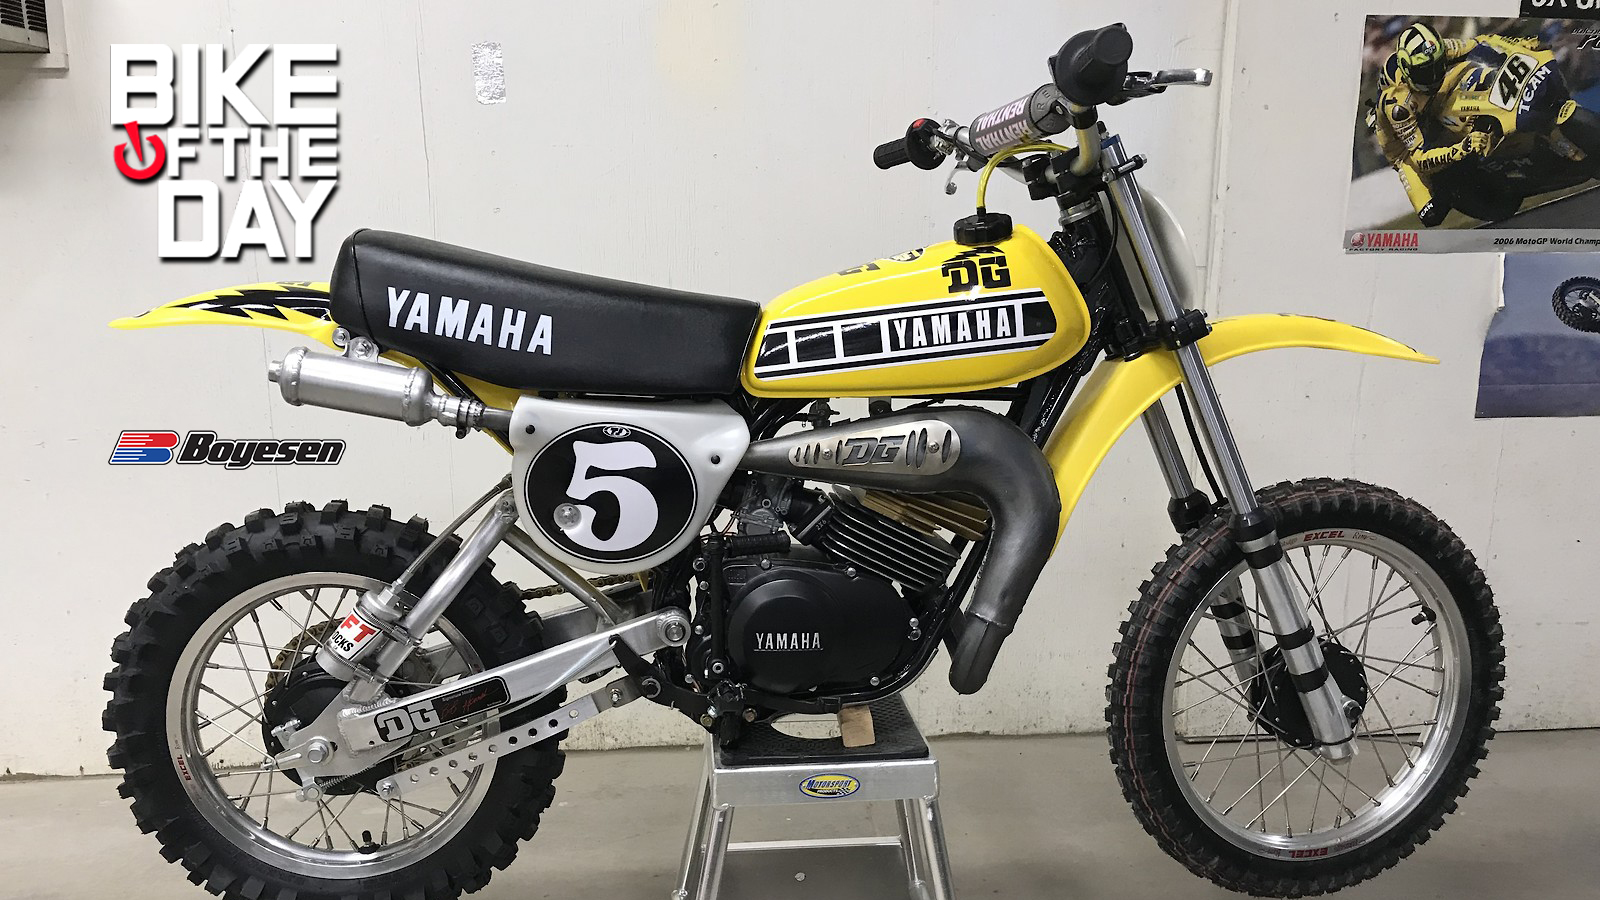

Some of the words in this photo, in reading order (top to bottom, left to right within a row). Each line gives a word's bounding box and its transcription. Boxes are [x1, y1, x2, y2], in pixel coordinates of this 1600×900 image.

[1498, 55, 1531, 106] 46
[976, 97, 1030, 132] RENTHAL
[1367, 233, 1419, 247] YAMAHA
[1493, 237, 1514, 245] 2006
[1515, 237, 1548, 245] MotoGP
[1550, 237, 1573, 245] World
[941, 255, 1011, 294] DG
[387, 286, 554, 356] YAMAHA
[893, 307, 1012, 349] YAMAHA
[842, 435, 906, 466] DG
[562, 441, 659, 551] 5
[1303, 530, 1345, 542] EXCEL
[755, 632, 821, 649] YAMAHA
[376, 699, 441, 742] DG
[177, 754, 192, 781] EXCEL
[1289, 847, 1328, 859] EXCEL
